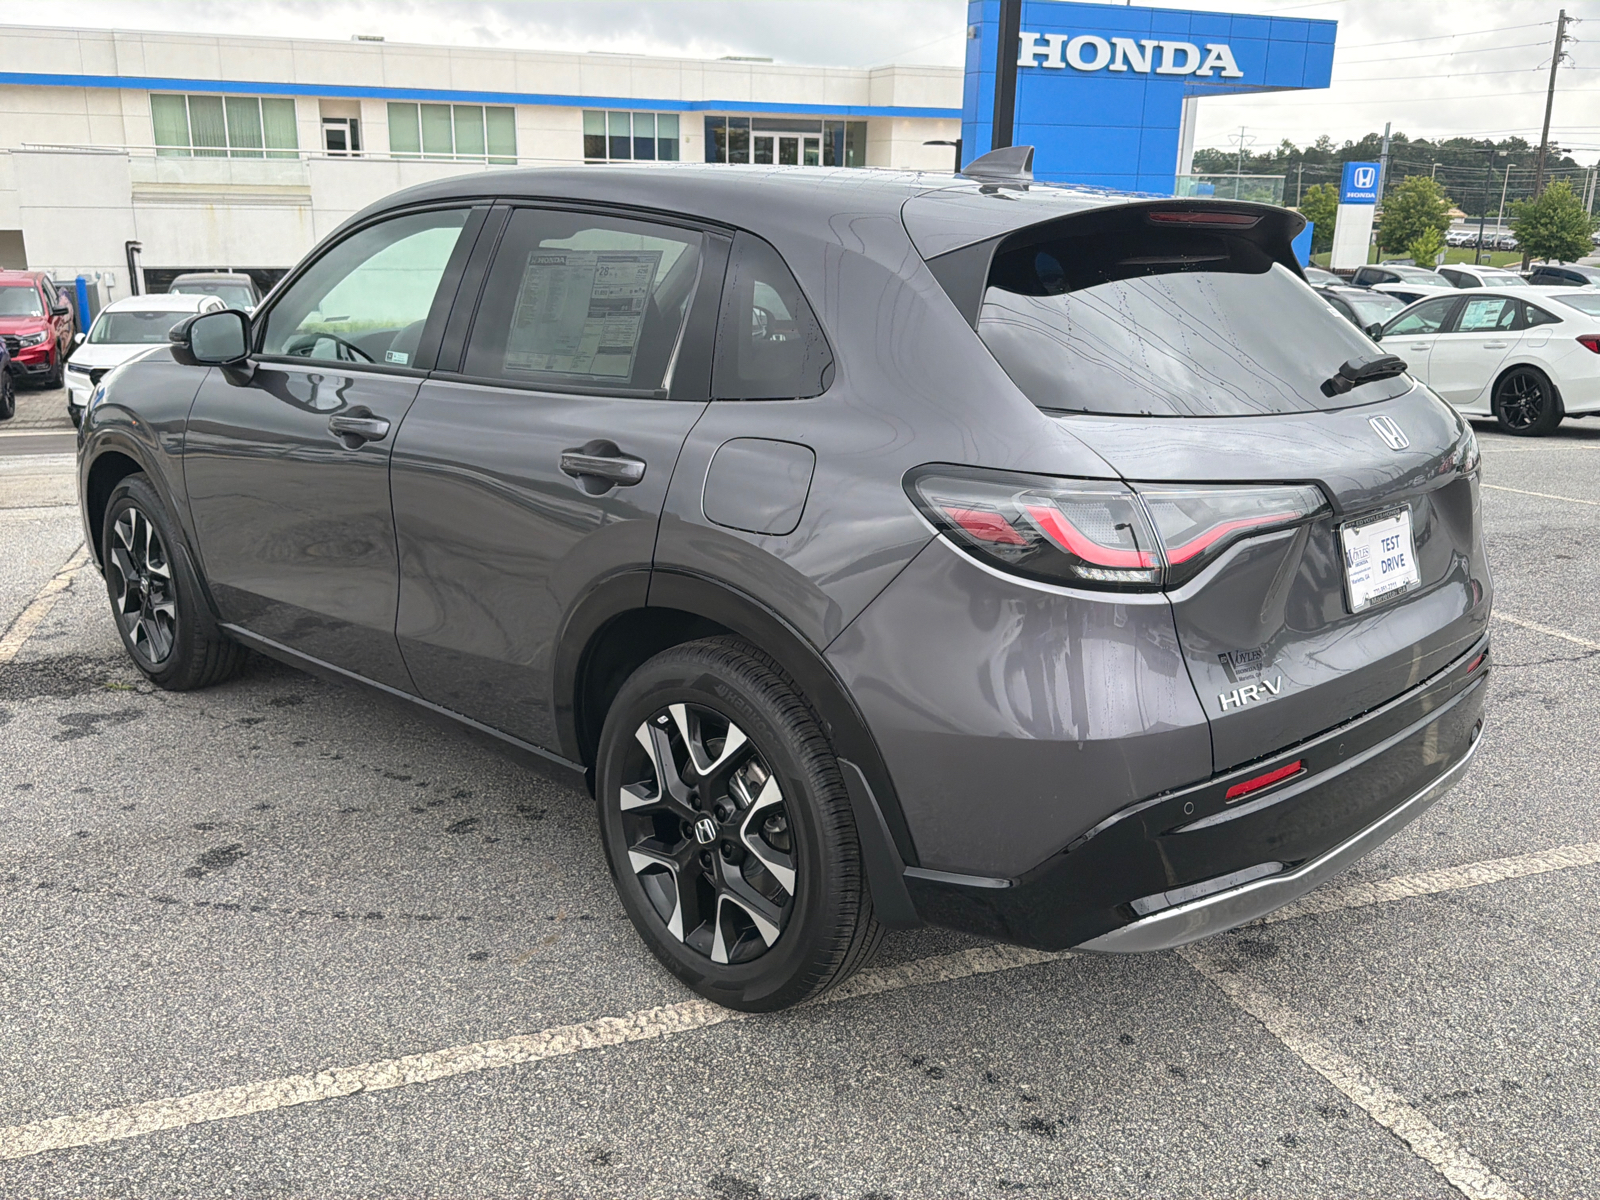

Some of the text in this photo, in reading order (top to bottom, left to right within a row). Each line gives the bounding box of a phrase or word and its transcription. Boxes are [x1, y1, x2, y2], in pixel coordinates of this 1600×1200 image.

[1017, 31, 1244, 78] HONDA
[538, 256, 566, 264] HONDA
[599, 266, 610, 277] 28
[1381, 534, 1400, 554] TEST
[1381, 553, 1406, 575] DRIVE
[1227, 649, 1262, 670] VOYLES
[1235, 664, 1258, 675] HONDA
[1218, 675, 1282, 712] HR-V
[724, 691, 781, 746] Hankoo
